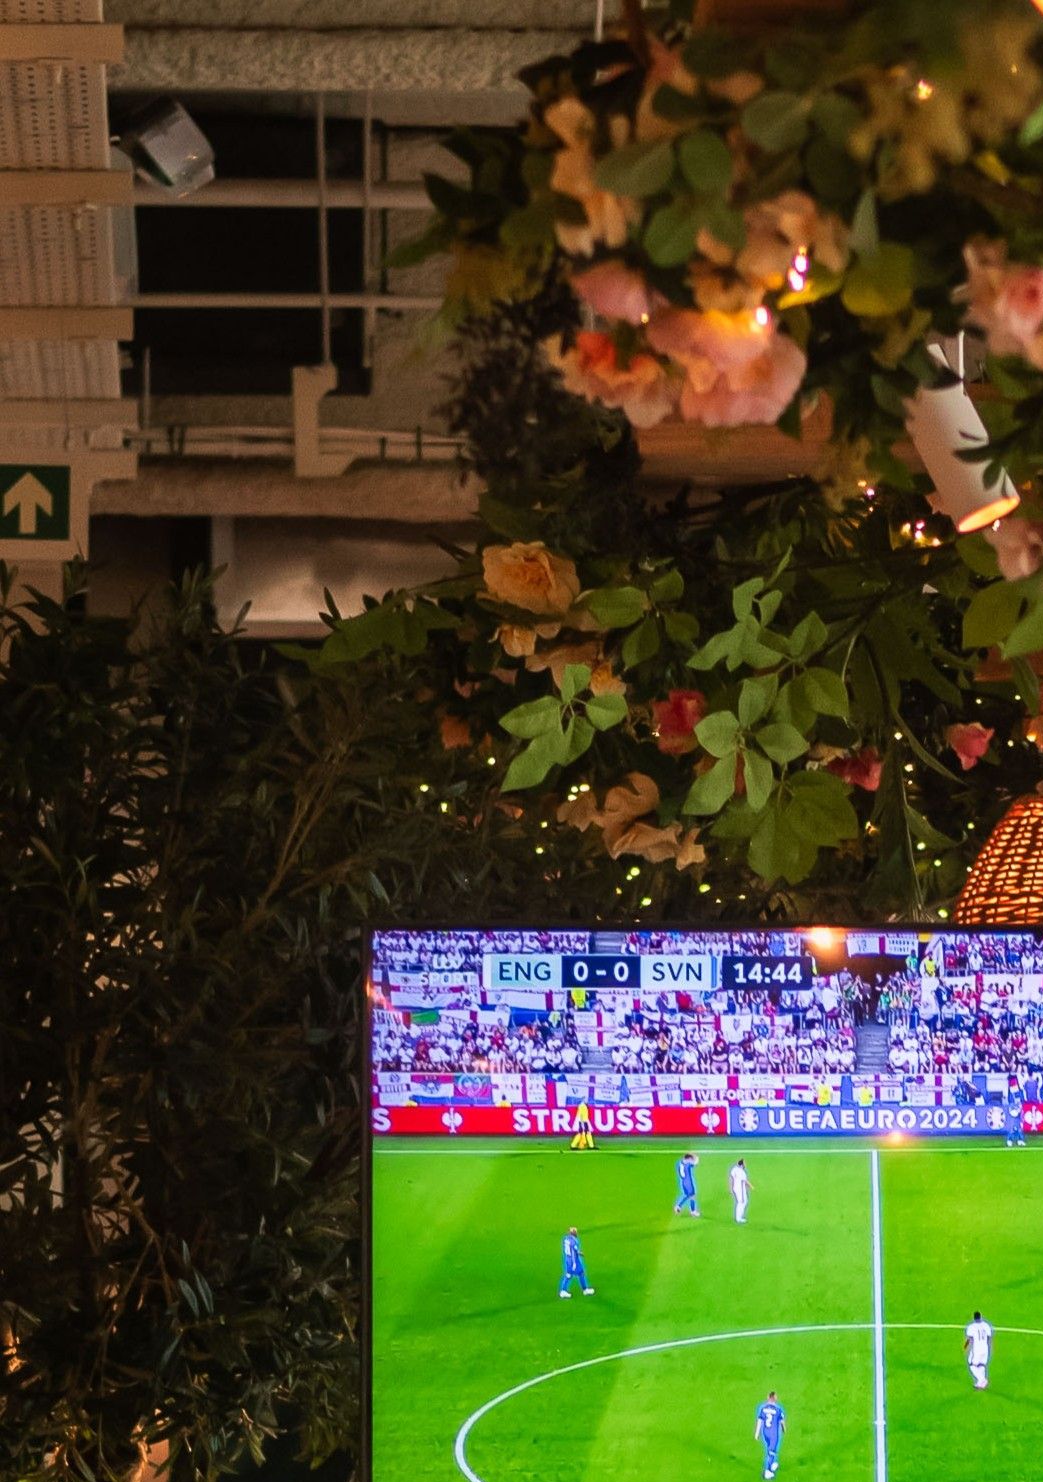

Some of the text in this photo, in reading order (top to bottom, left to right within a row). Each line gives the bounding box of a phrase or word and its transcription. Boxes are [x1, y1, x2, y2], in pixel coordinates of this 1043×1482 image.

[499, 961, 551, 981] ENG
[652, 962, 702, 982] SVN
[733, 962, 802, 984] 14:44
